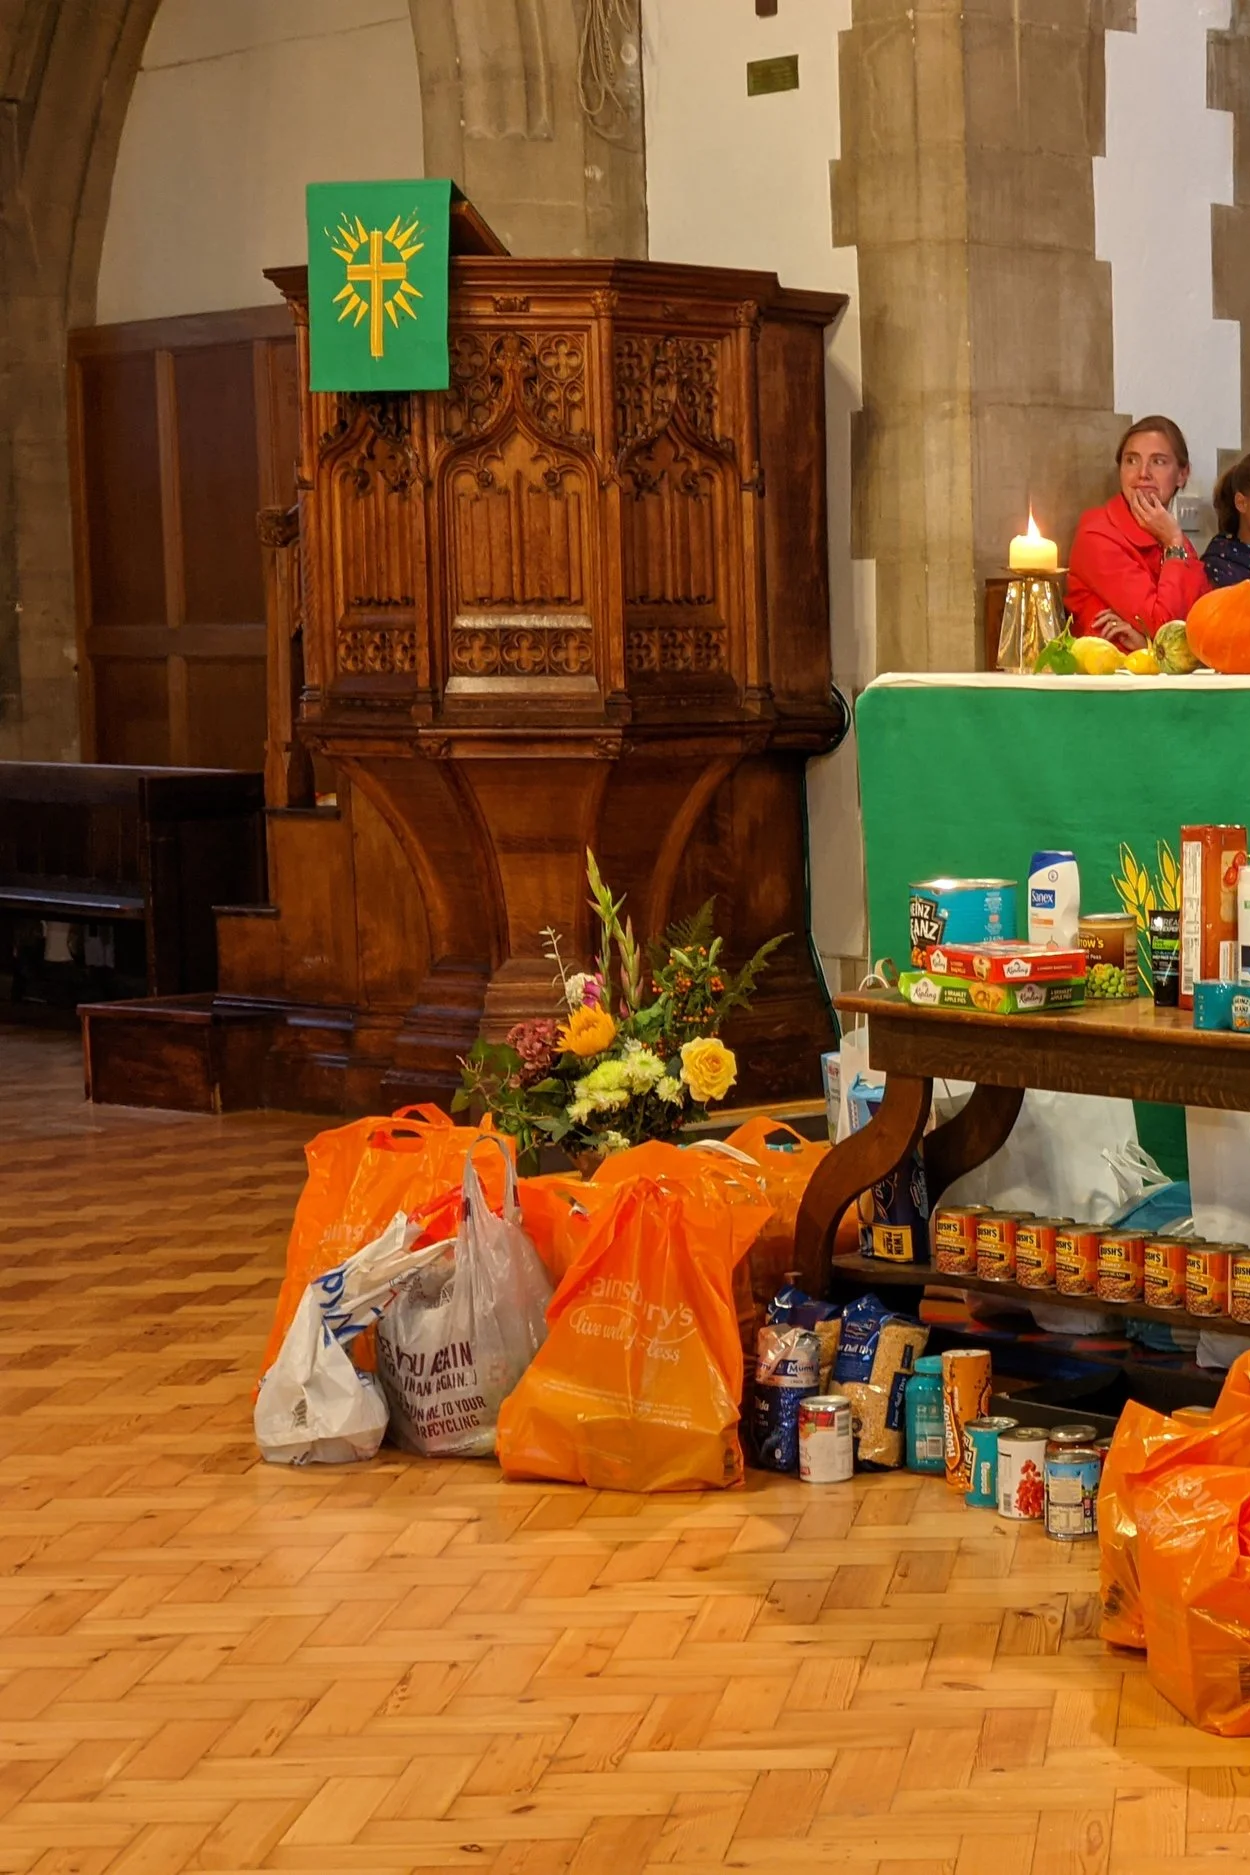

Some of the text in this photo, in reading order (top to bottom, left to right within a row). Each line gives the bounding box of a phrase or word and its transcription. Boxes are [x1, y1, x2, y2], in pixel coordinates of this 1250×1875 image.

[1031, 890, 1054, 904] Sanex
[441, 1402, 454, 1417] TO
[454, 1396, 487, 1414] YOUR
